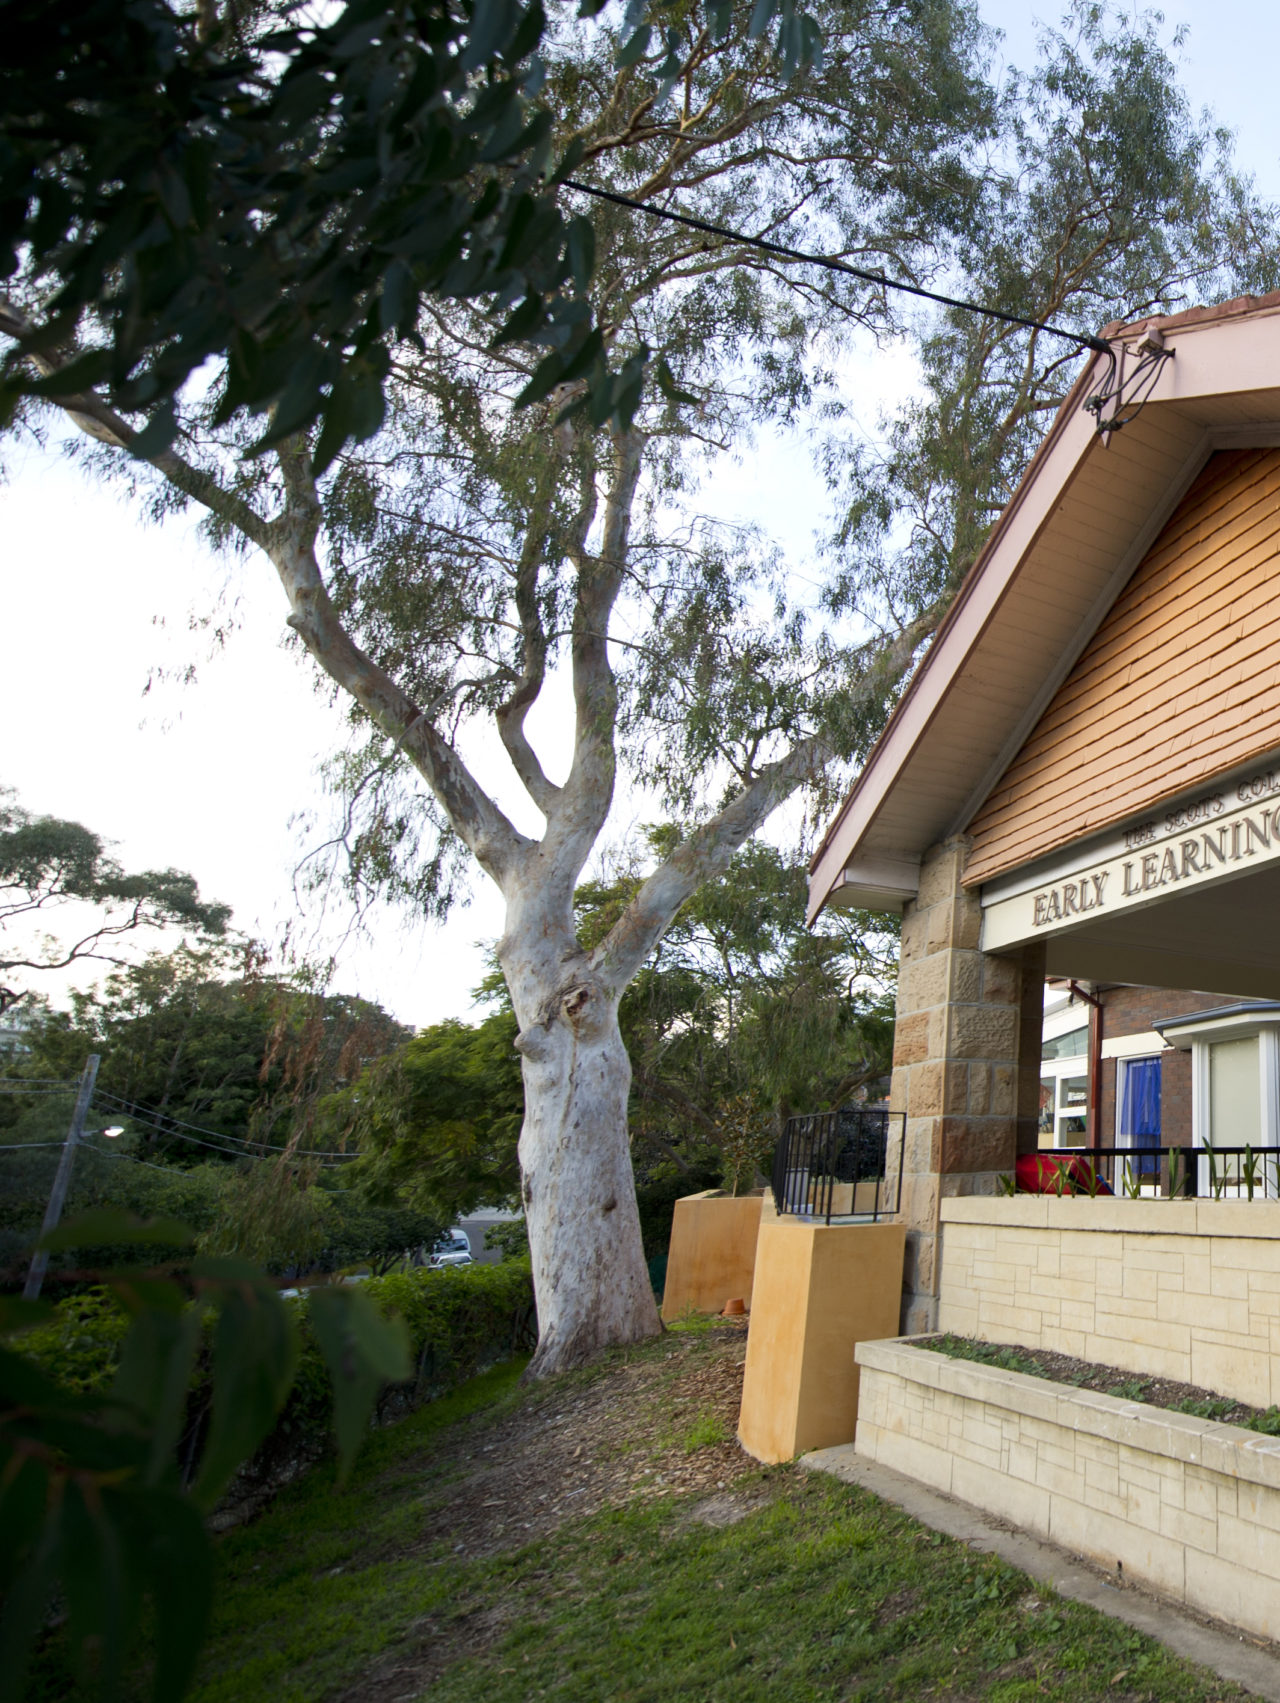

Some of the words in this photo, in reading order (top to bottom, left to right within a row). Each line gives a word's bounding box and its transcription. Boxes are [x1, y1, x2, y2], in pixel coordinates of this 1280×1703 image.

[1122, 821, 1156, 849] THE
[1164, 792, 1225, 833] SCOTS
[1032, 870, 1109, 926] EARLY
